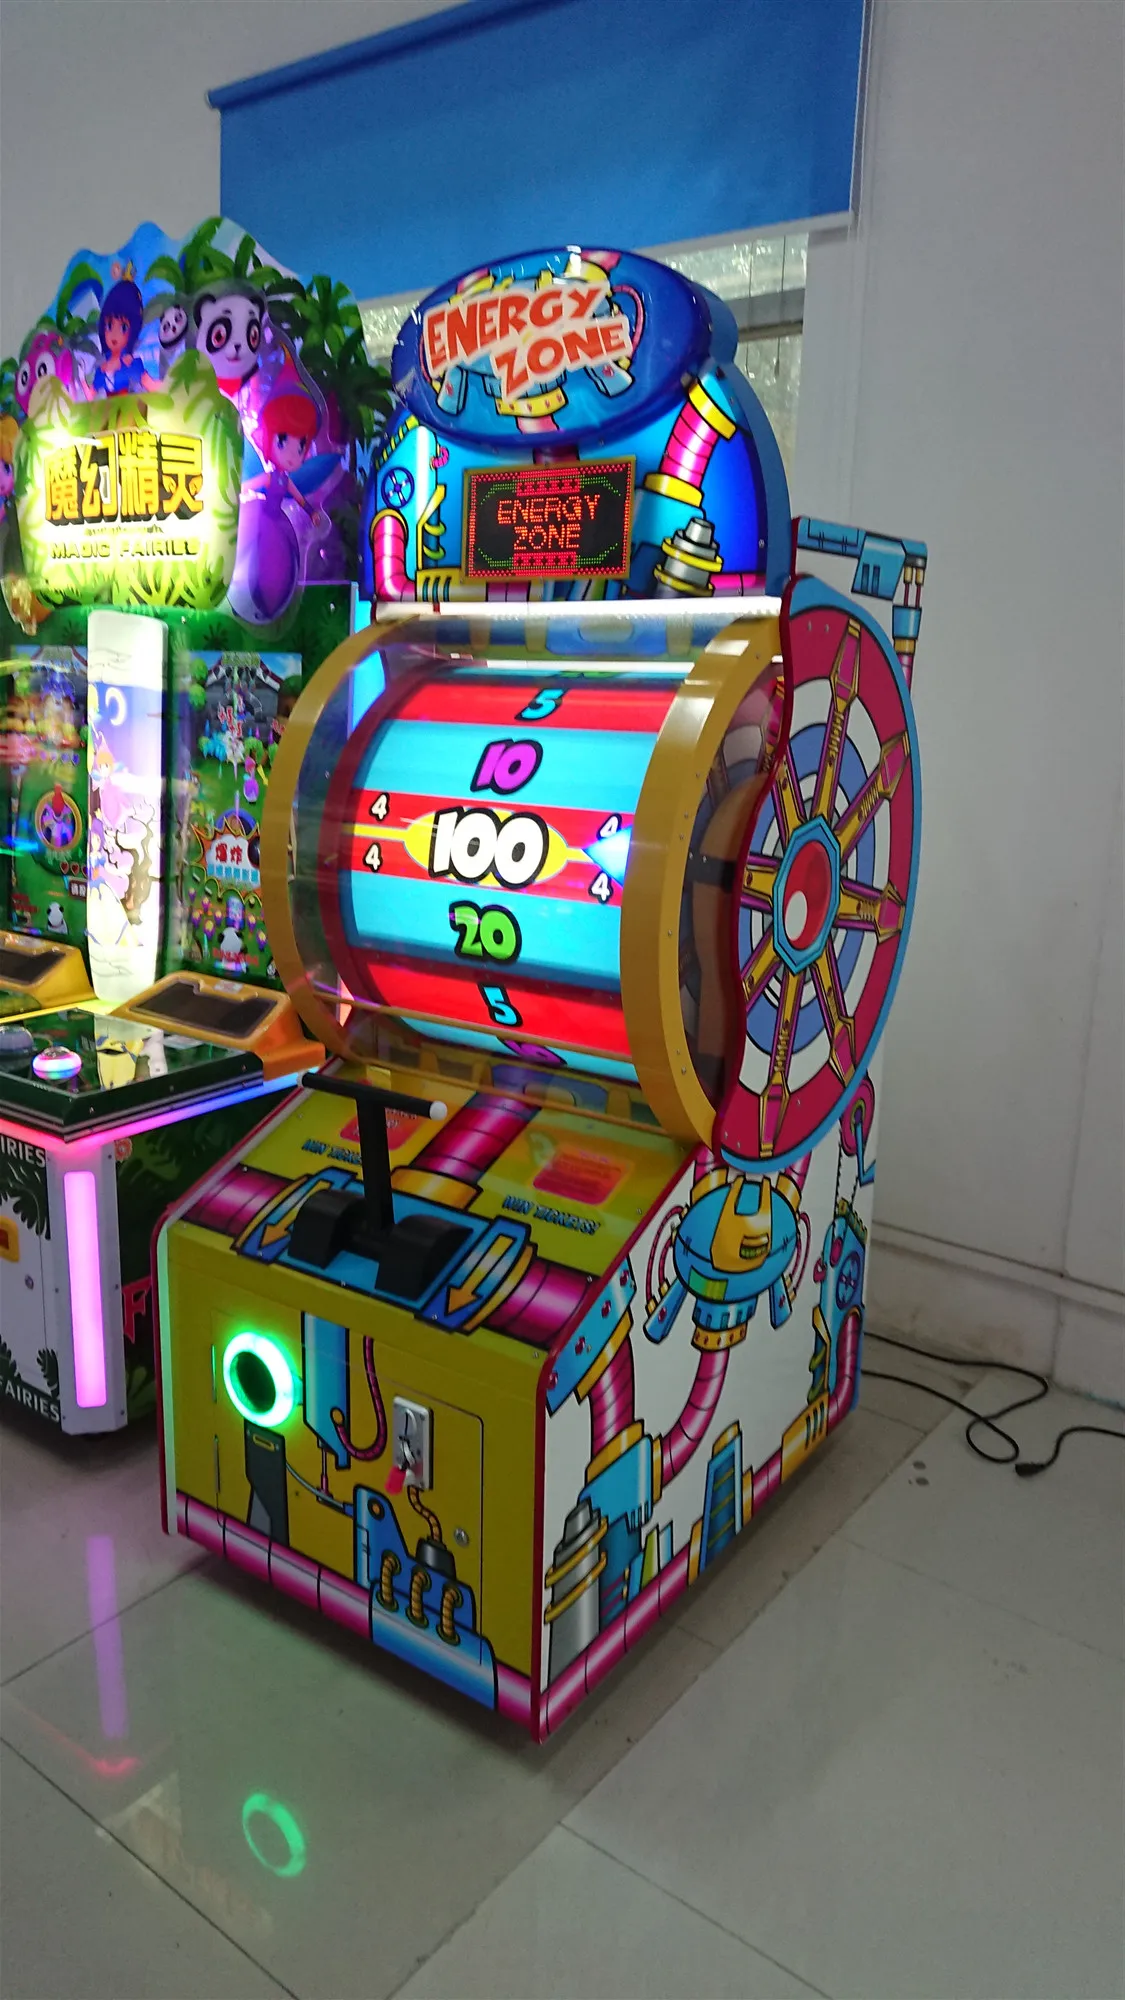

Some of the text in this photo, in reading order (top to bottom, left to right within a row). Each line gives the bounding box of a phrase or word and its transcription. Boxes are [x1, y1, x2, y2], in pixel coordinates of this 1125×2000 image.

[425, 287, 604, 369] ENERGY
[493, 322, 627, 398] ZONE
[45, 431, 204, 525] 魔幻精灵
[497, 494, 601, 525] ENERGY
[512, 524, 581, 550] ZONE
[518, 688, 566, 720] 5
[471, 740, 542, 793] 10
[370, 793, 389, 820] 4
[364, 843, 382, 872] 4
[429, 807, 547, 888] 100
[589, 871, 612, 904] 4
[450, 902, 521, 961] 20
[481, 985, 522, 1026] 5
